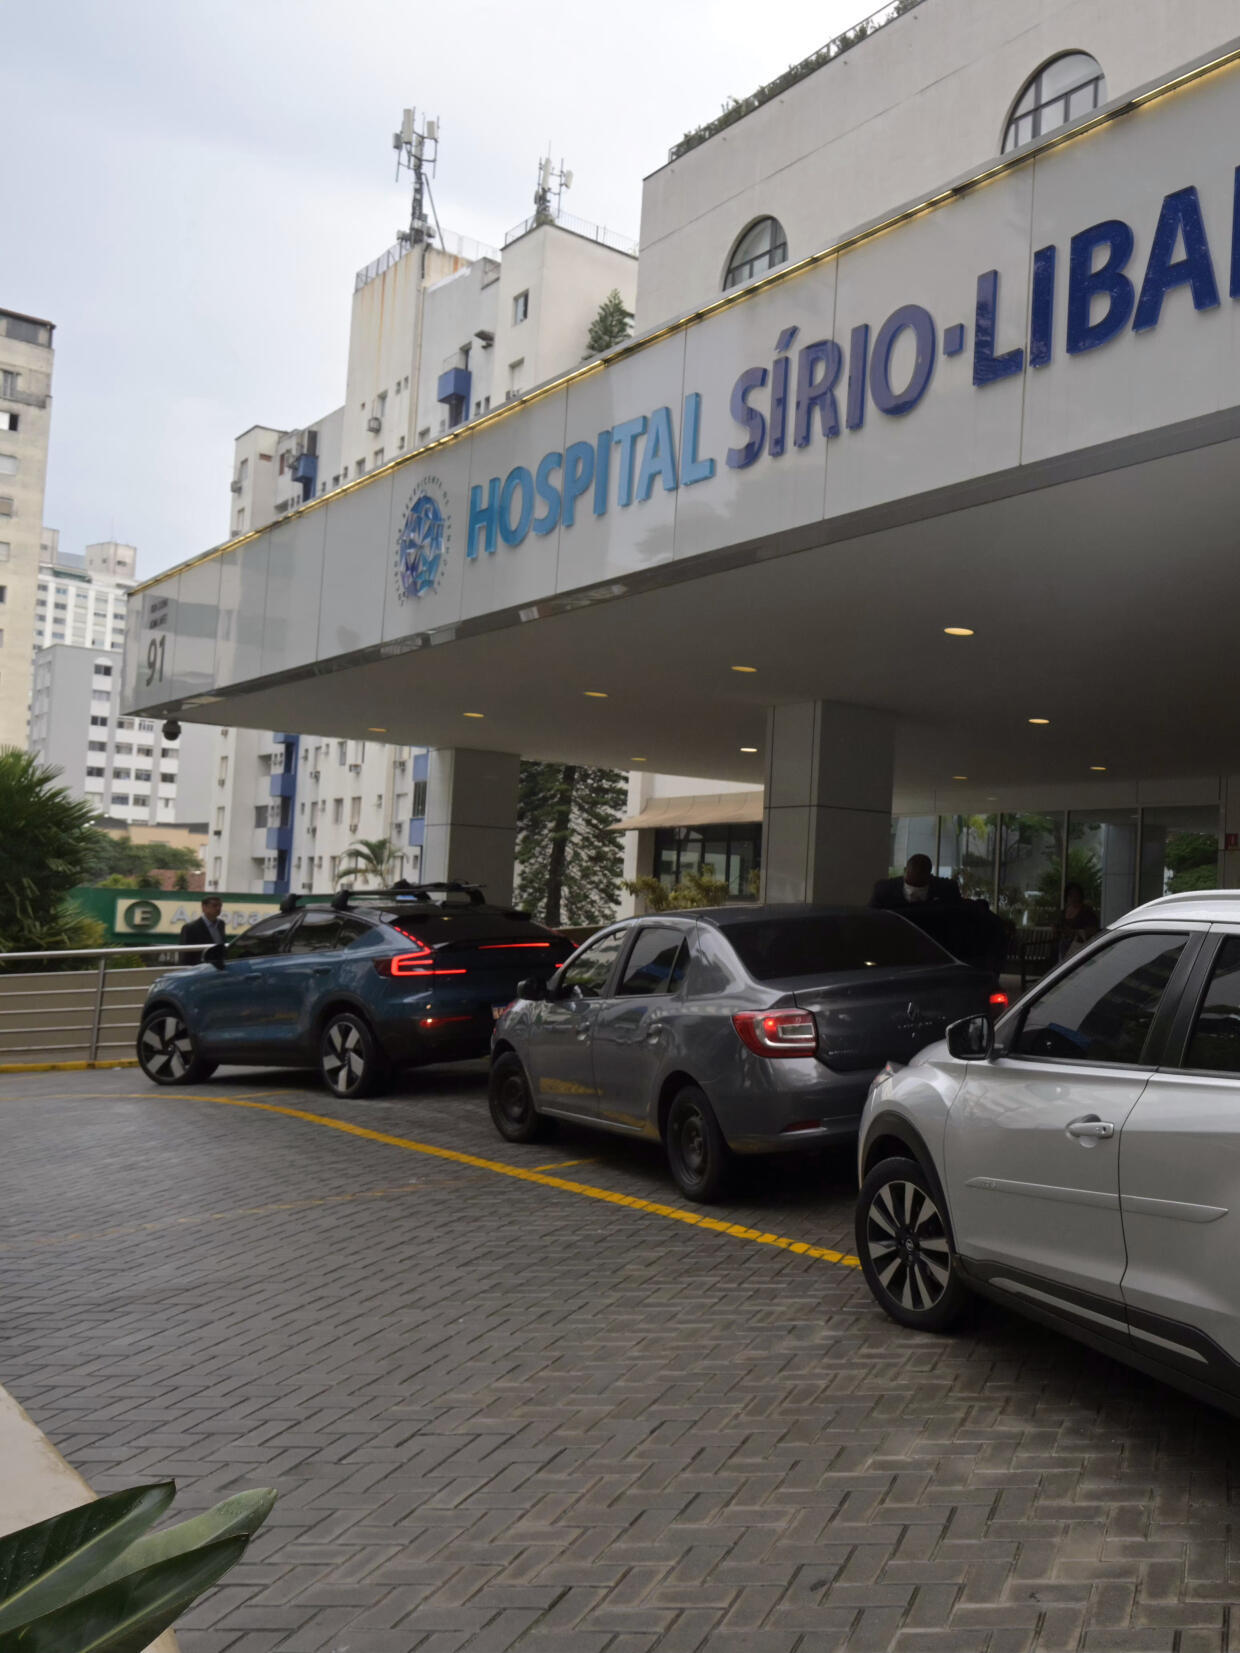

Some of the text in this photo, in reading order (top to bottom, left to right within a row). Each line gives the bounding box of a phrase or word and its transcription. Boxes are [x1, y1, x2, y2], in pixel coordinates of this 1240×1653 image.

[466, 392, 716, 560] HOSPITAL
[146, 633, 166, 688] 91
[134, 907, 154, 926] E
